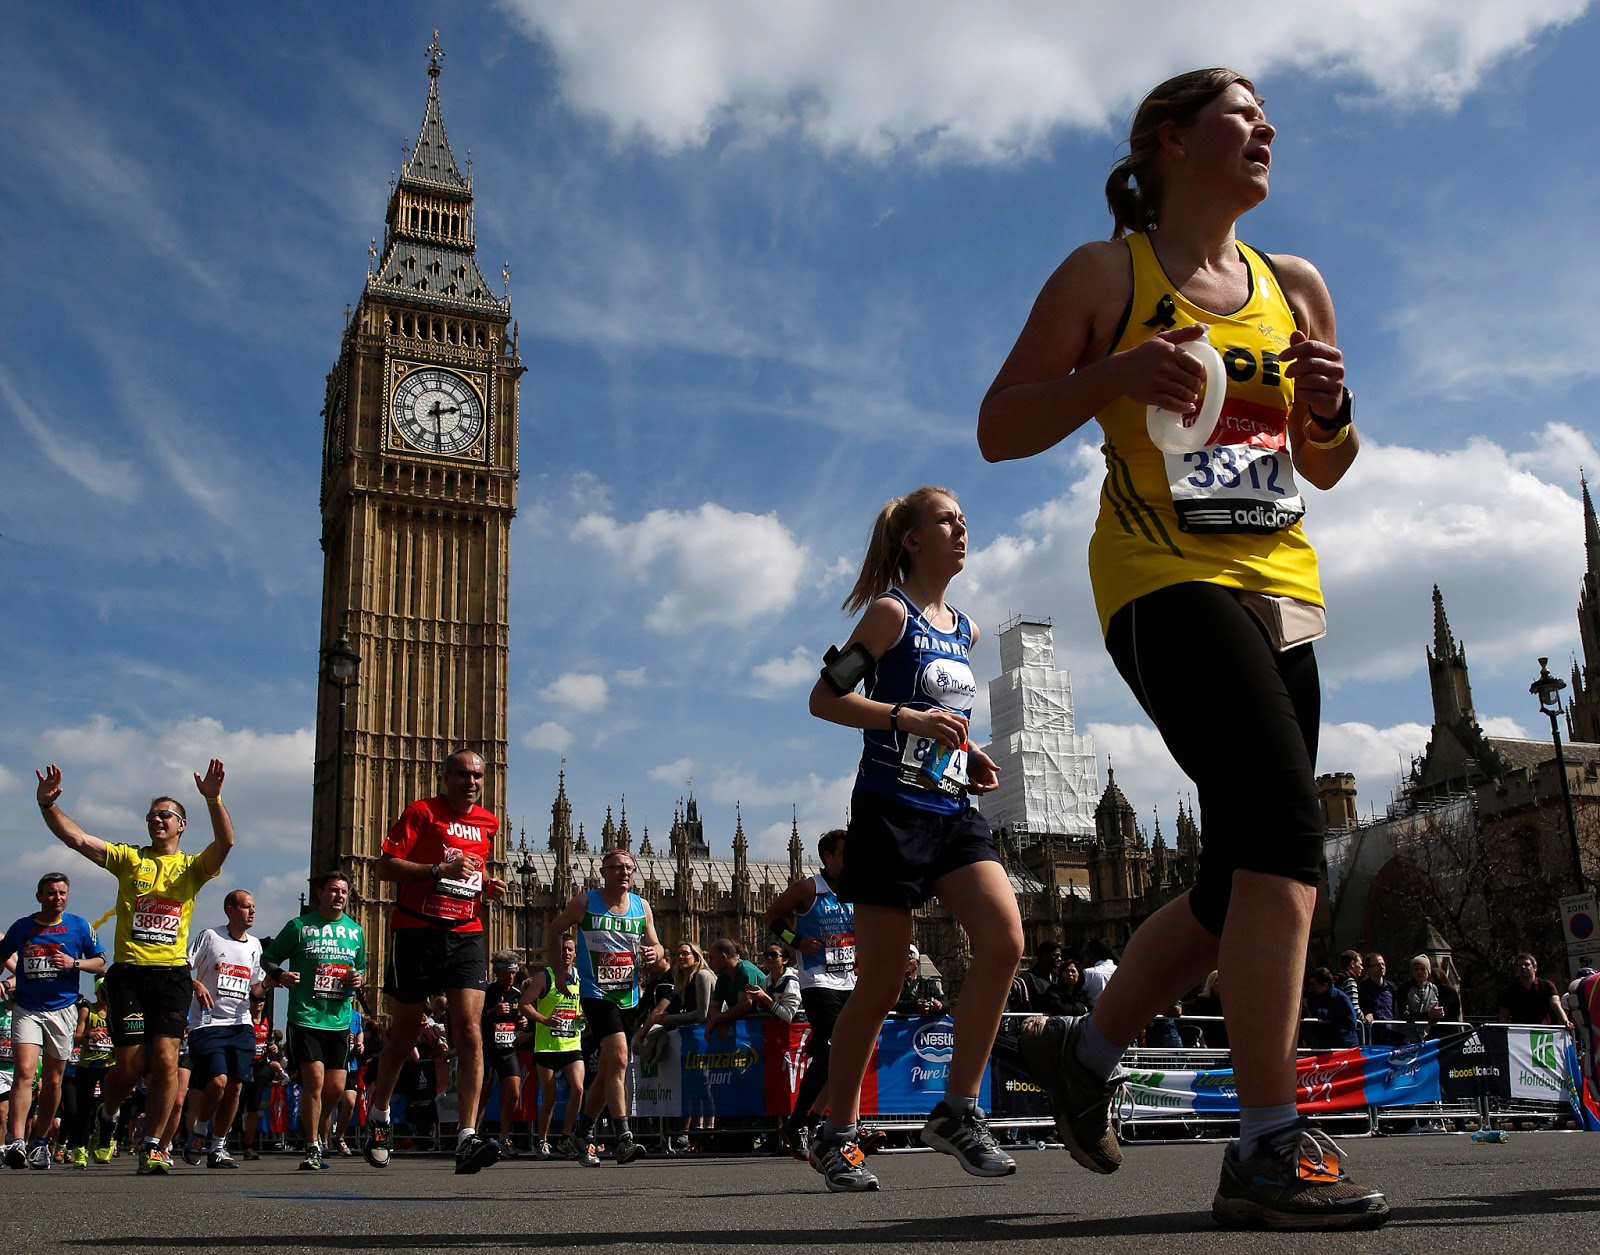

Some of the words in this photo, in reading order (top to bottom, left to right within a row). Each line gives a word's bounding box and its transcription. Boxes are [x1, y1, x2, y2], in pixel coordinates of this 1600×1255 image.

[1225, 414, 1277, 436] money
[937, 778, 960, 796] didas
[446, 821, 482, 842] JOHN
[452, 887, 476, 898] adidas
[825, 904, 854, 915] RYAN
[1567, 902, 1590, 913] ZONE
[135, 914, 180, 931] 38922
[592, 916, 640, 933] WOODY
[302, 924, 359, 941] MARK
[306, 940, 320, 948] WE
[321, 939, 338, 947] ARE
[600, 967, 632, 980] 33872
[1462, 1044, 1485, 1054] adidas
[685, 1047, 748, 1070] Lucozade
[704, 1071, 734, 1086] Sport
[911, 1066, 940, 1083] Pure
[1519, 1070, 1557, 1091] Holiday
